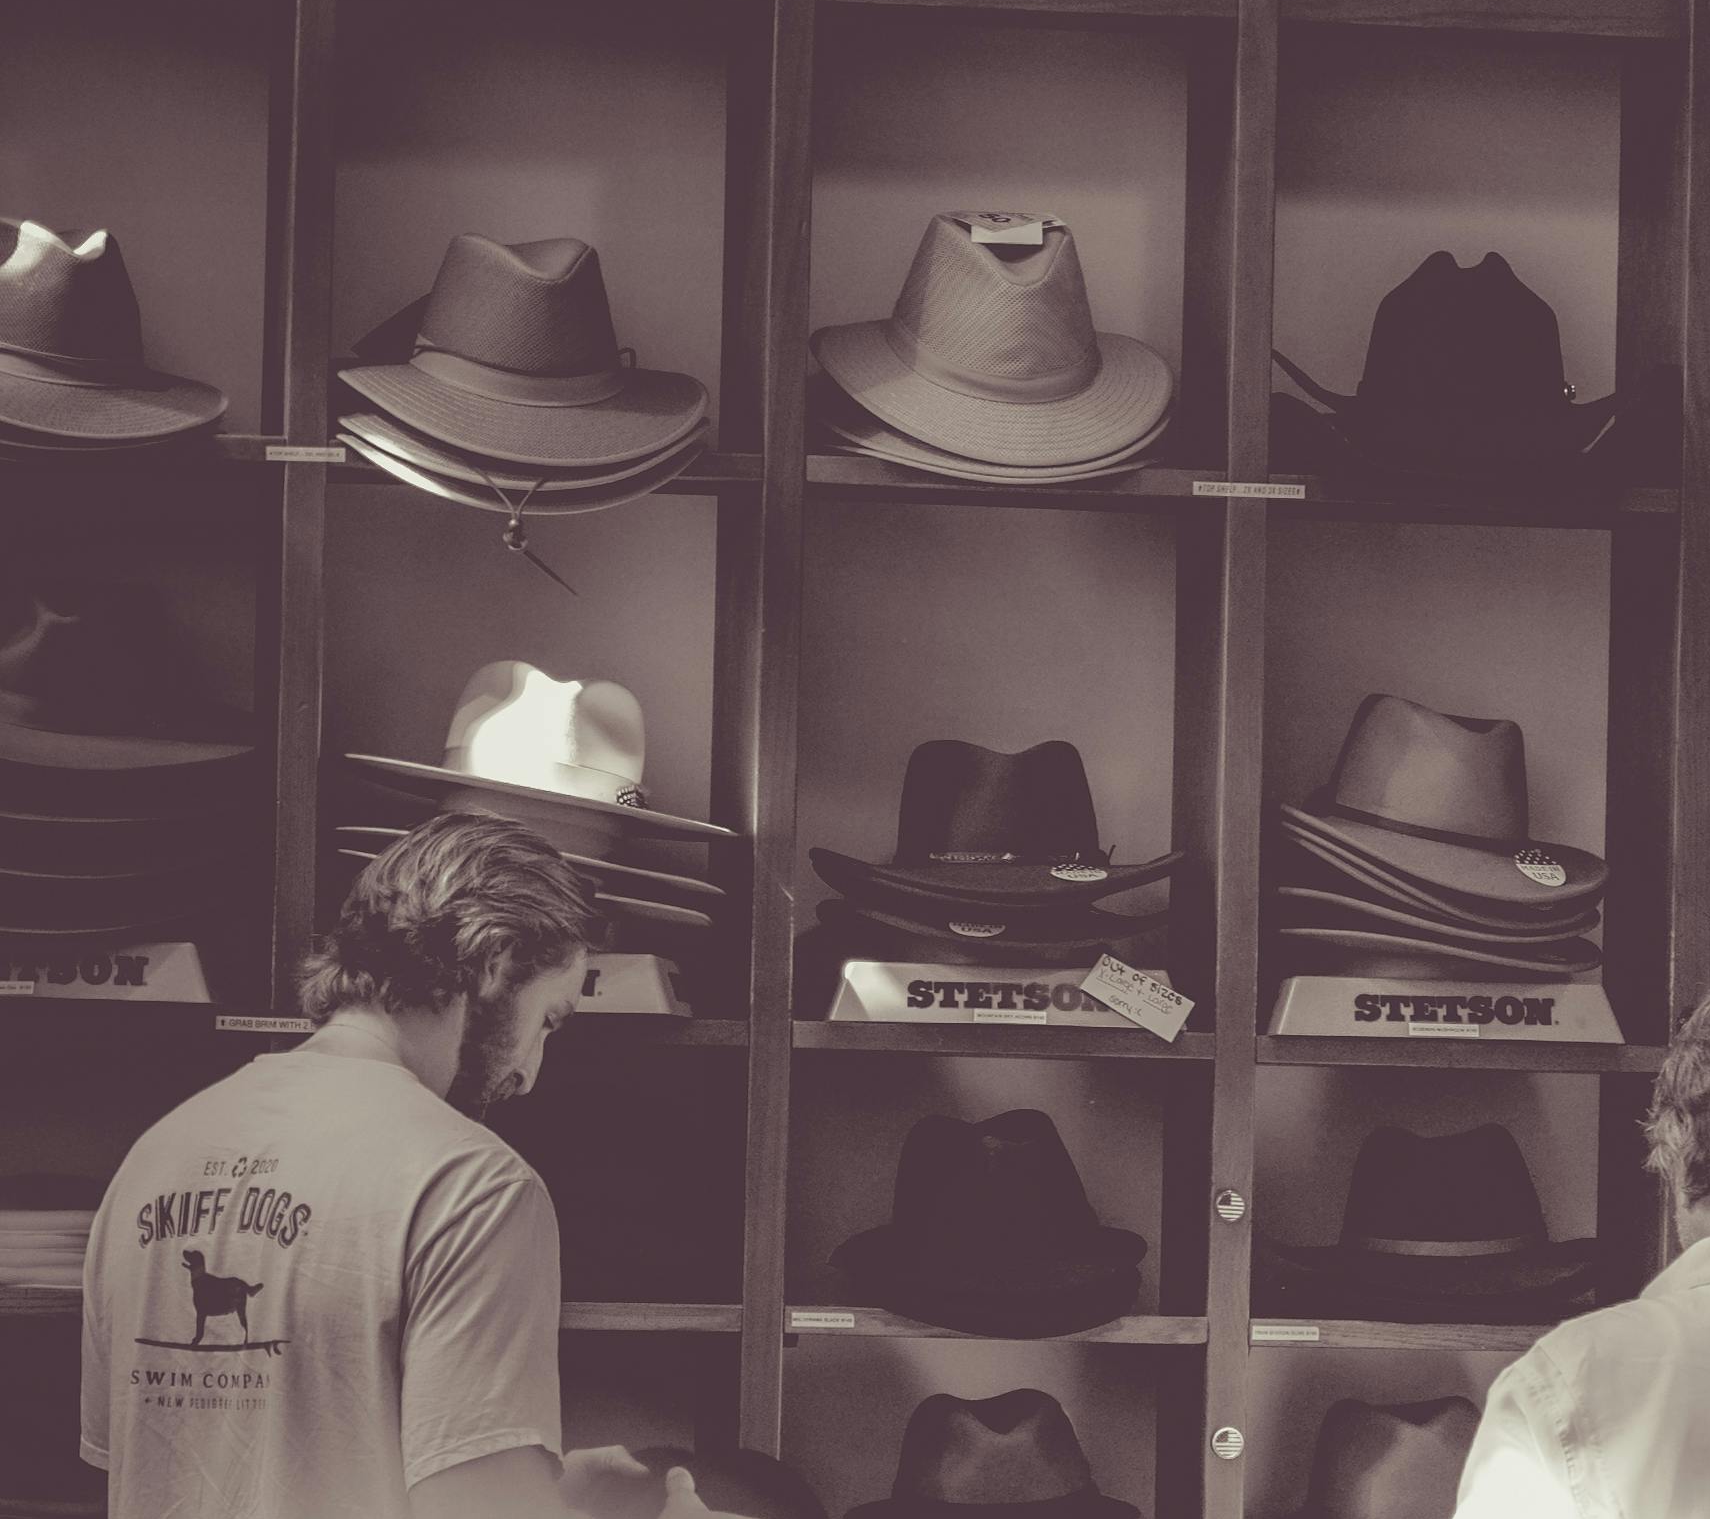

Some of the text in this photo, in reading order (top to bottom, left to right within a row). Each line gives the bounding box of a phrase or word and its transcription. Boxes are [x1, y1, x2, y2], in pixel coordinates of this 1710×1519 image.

[1532, 872, 1560, 881] USA
[1355, 994, 1556, 1025] STETSON
[279, 1021, 301, 1030] WITH
[251, 1158, 280, 1175] 2020
[138, 1187, 312, 1249] SKIFF DOGS
[130, 1369, 193, 1388] SWIM
[158, 1396, 185, 1408] NEW
